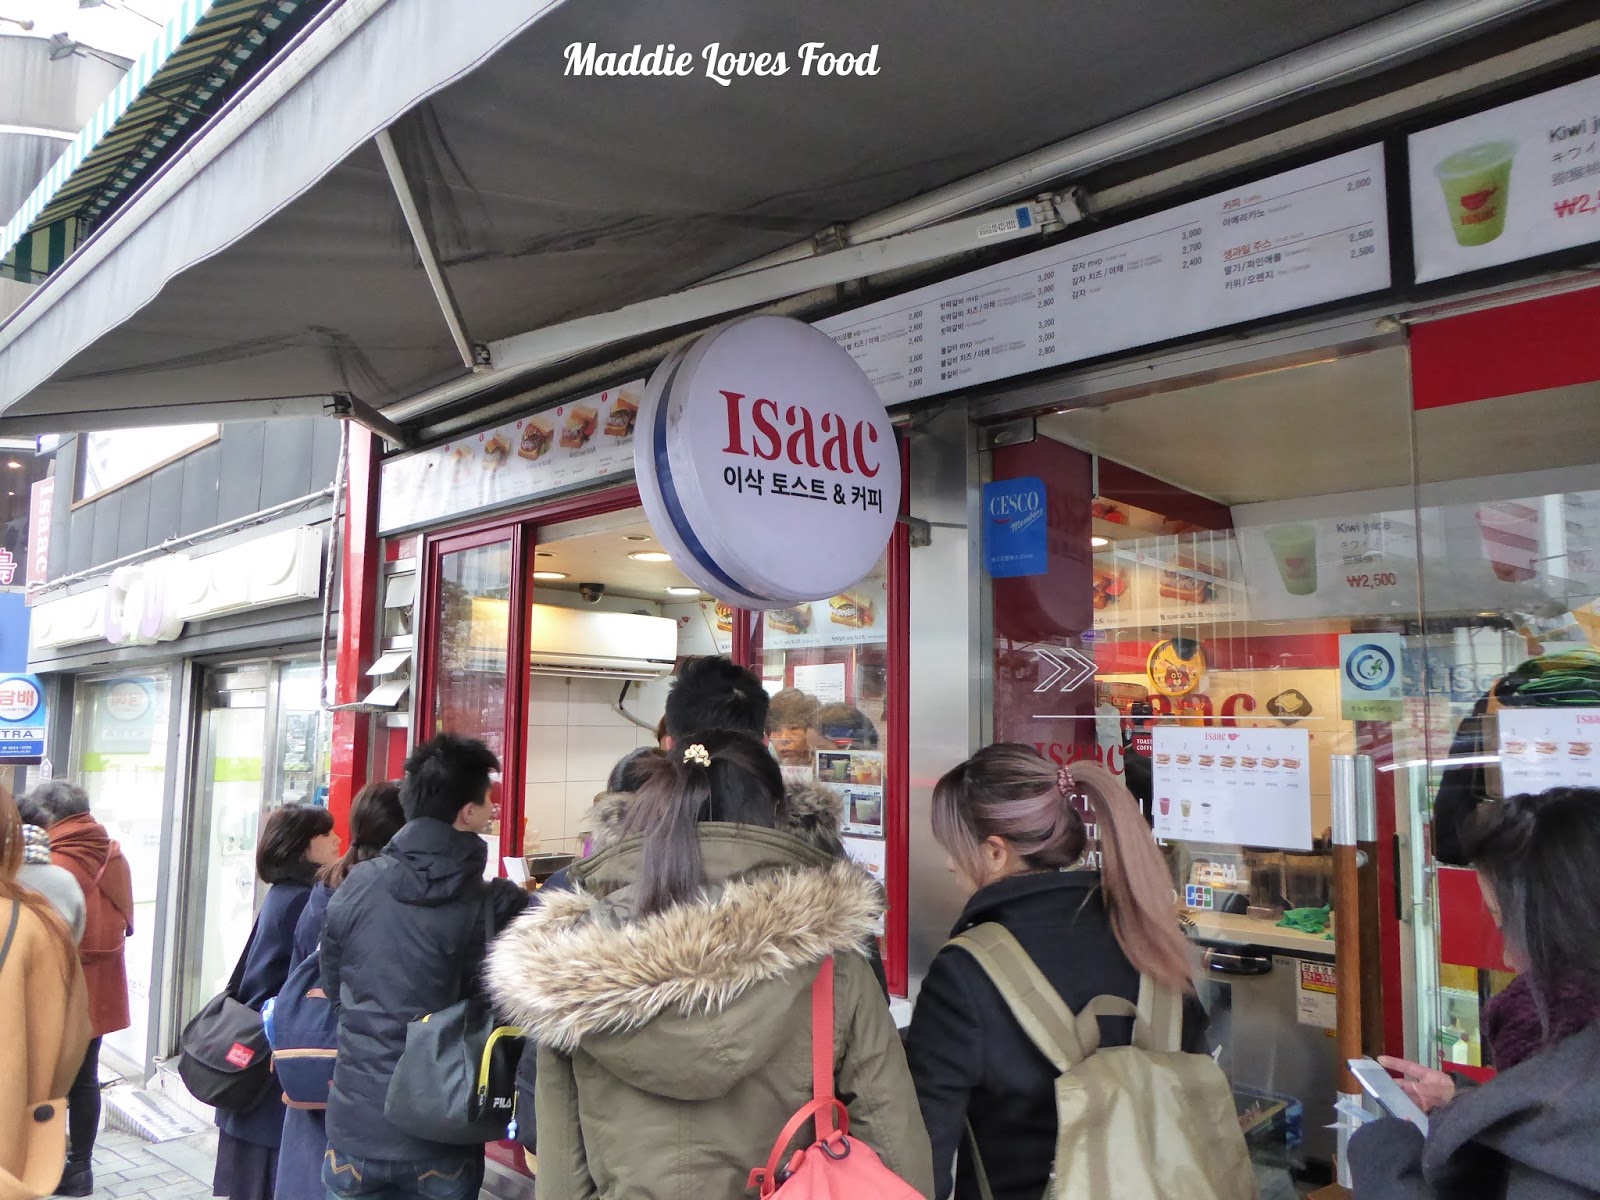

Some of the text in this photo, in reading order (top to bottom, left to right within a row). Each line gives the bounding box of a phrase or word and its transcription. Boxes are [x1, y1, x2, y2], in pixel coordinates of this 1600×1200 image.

[1548, 119, 1587, 143] Kiwi
[1347, 177, 1371, 192] 2,000
[1223, 197, 1240, 210] 커피
[1222, 210, 1265, 226] 아메리카노
[1182, 228, 1202, 240] 3,000
[1350, 228, 1374, 242] 2,500
[1182, 242, 1202, 254] 2,700
[1223, 239, 1272, 260] 생과일 주스
[1350, 245, 1374, 260] 2,500
[1072, 258, 1102, 272] 감자 mvp
[1182, 257, 1202, 269] 2,400
[1038, 271, 1054, 282] 3,200
[1072, 276, 1086, 286] 감자
[1088, 270, 1102, 280] 치즈
[1109, 264, 1124, 274] 야채
[1224, 270, 1274, 290] 키위/오렌지
[1038, 284, 1054, 296] 3,000
[1072, 289, 1086, 300] 감자
[966, 295, 978, 303] mvp
[966, 307, 978, 315] 치즈
[1038, 318, 1055, 329] 3,200
[1038, 332, 1055, 342] 3,000
[854, 340, 864, 348] 치즈
[960, 353, 972, 361] 치즈
[978, 348, 990, 357] 야채
[719, 390, 880, 478] Isaac
[723, 466, 882, 513] 이삭 토스트 & 커피
[990, 491, 1039, 516] CESCO
[36, 484, 54, 573] Isaac
[1336, 522, 1360, 533] Kiwi
[1346, 573, 1396, 589] ₩2,500
[1205, 732, 1226, 741] Isaac
[493, 1097, 511, 1108] FILA
